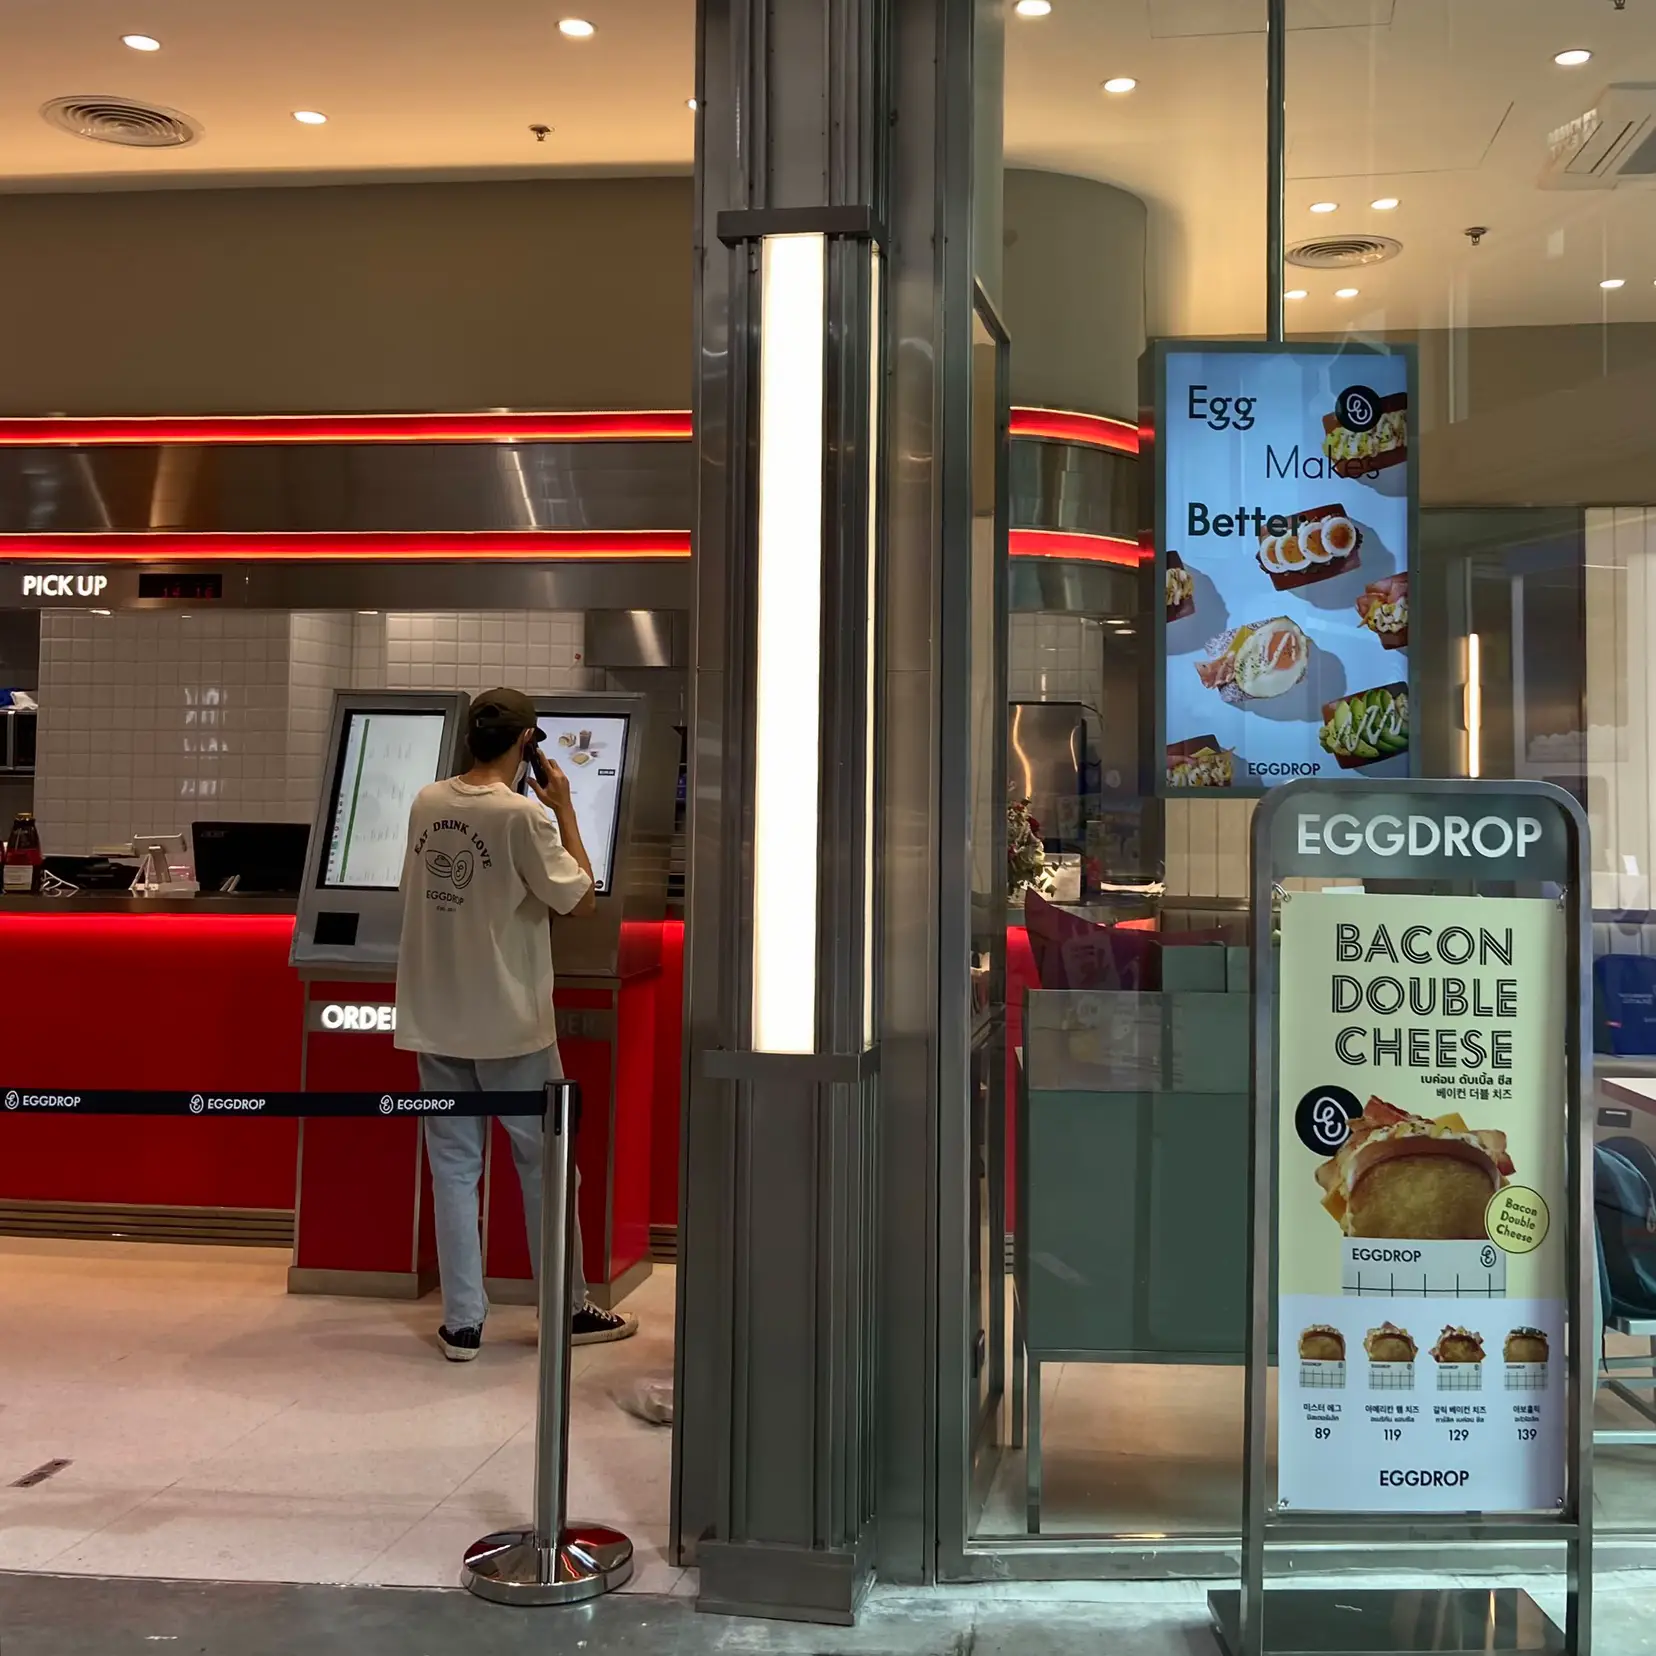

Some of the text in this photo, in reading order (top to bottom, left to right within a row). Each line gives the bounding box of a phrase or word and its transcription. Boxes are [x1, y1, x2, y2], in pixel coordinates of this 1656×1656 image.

[1188, 384, 1257, 431] Egg
[1266, 444, 1380, 480] Makes
[1187, 501, 1307, 538] Better
[23, 575, 108, 597] PICK UP
[1248, 761, 1321, 776] EGGDROP
[414, 819, 493, 870] EAT DRINK LOVE
[1297, 812, 1544, 859] EGGDROP
[426, 889, 464, 906] EGGDROP
[1335, 922, 1514, 967] BACON
[1331, 973, 1518, 1019] DOUBLE
[321, 1004, 396, 1031] ORDE
[1334, 1025, 1513, 1070] CHEESE
[22, 1095, 82, 1108] EGGDROP
[1436, 1087, 1513, 1100] 베이컨 더블 치즈
[206, 1098, 266, 1110] EGGDROP
[397, 1099, 456, 1111] EGGDROP
[1505, 1197, 1538, 1217] Bacon
[1500, 1210, 1536, 1230] Double
[1496, 1223, 1533, 1243] Cheese
[1352, 1247, 1422, 1263] EGGDROP
[1314, 1427, 1331, 1440] 89
[1384, 1428, 1402, 1441] 119
[1448, 1429, 1469, 1441] 129
[1517, 1428, 1538, 1441] 139
[1379, 1469, 1470, 1487] EGGDROP
